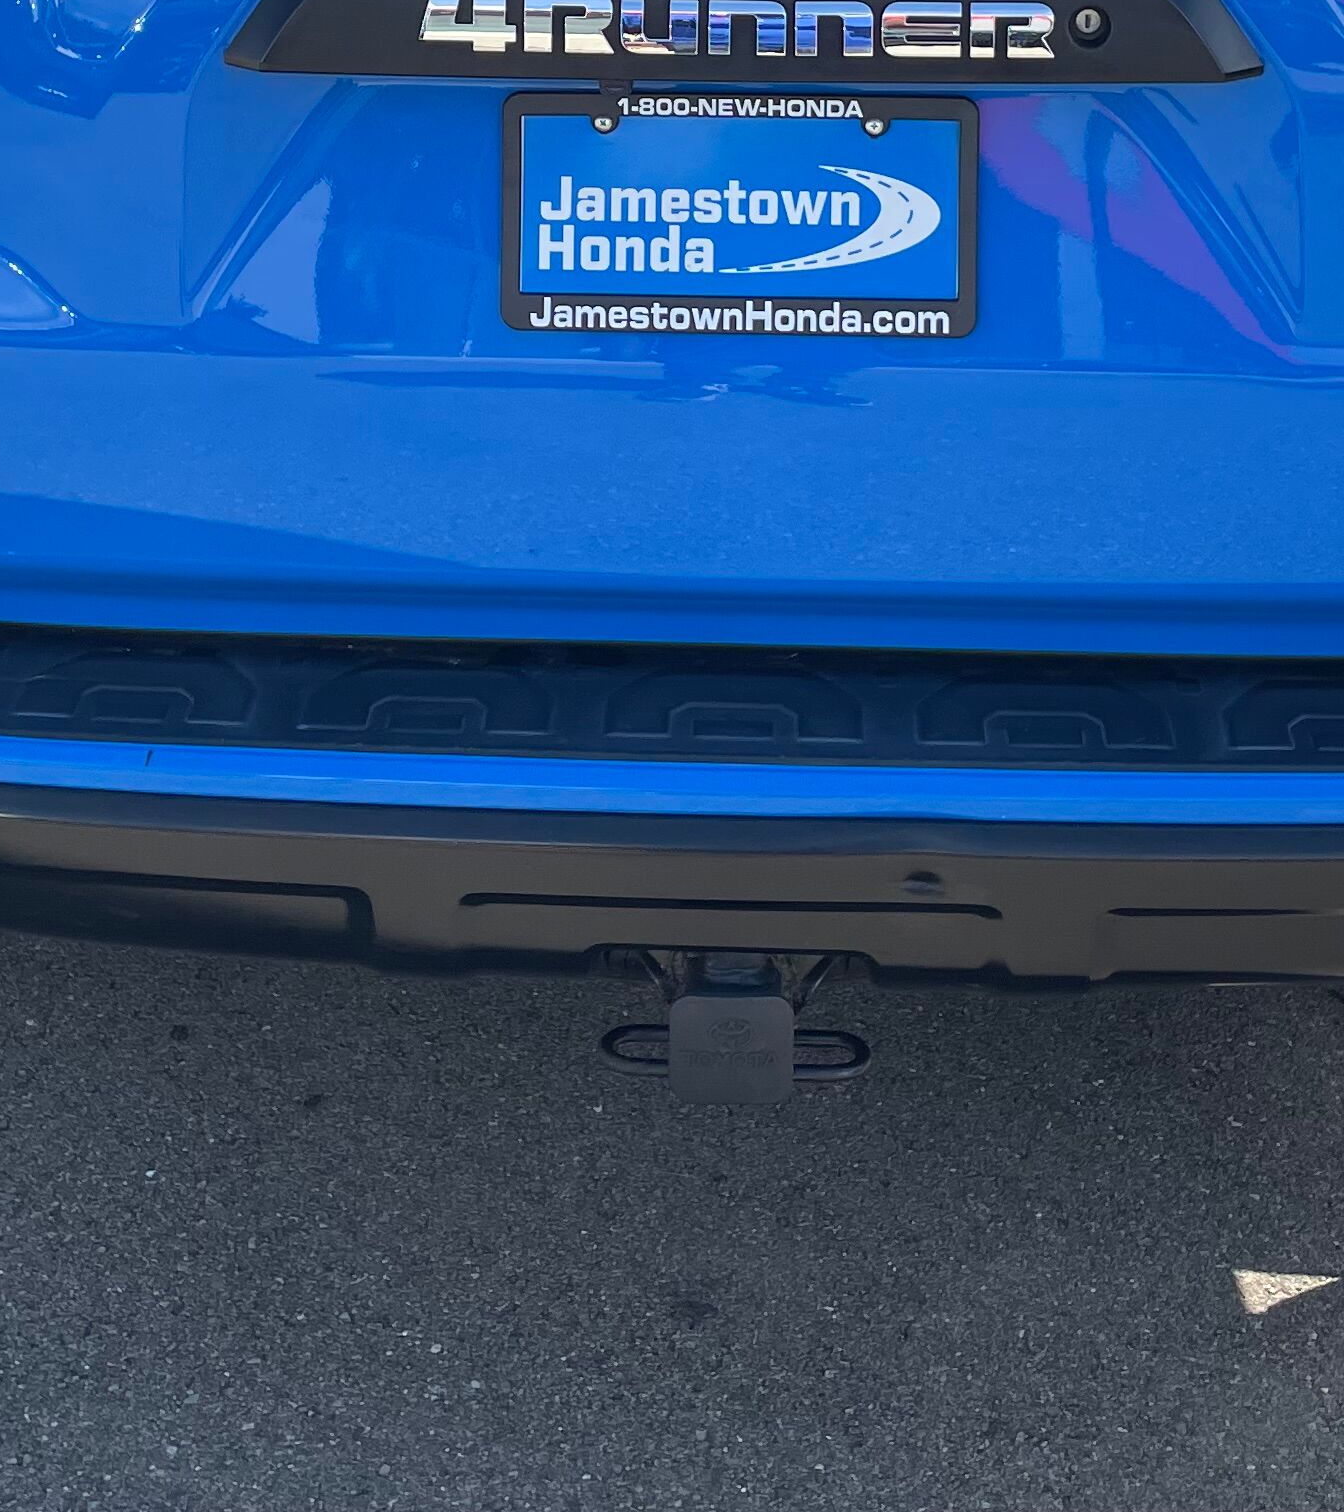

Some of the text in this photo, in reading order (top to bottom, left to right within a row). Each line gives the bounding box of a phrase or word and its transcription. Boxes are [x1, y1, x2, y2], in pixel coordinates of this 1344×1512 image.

[617, 97, 864, 119] 1-800-NEW-HONDA
[539, 175, 861, 227] Jamestown
[537, 224, 715, 274] Honda
[529, 296, 950, 335] JamestownHonda.com
